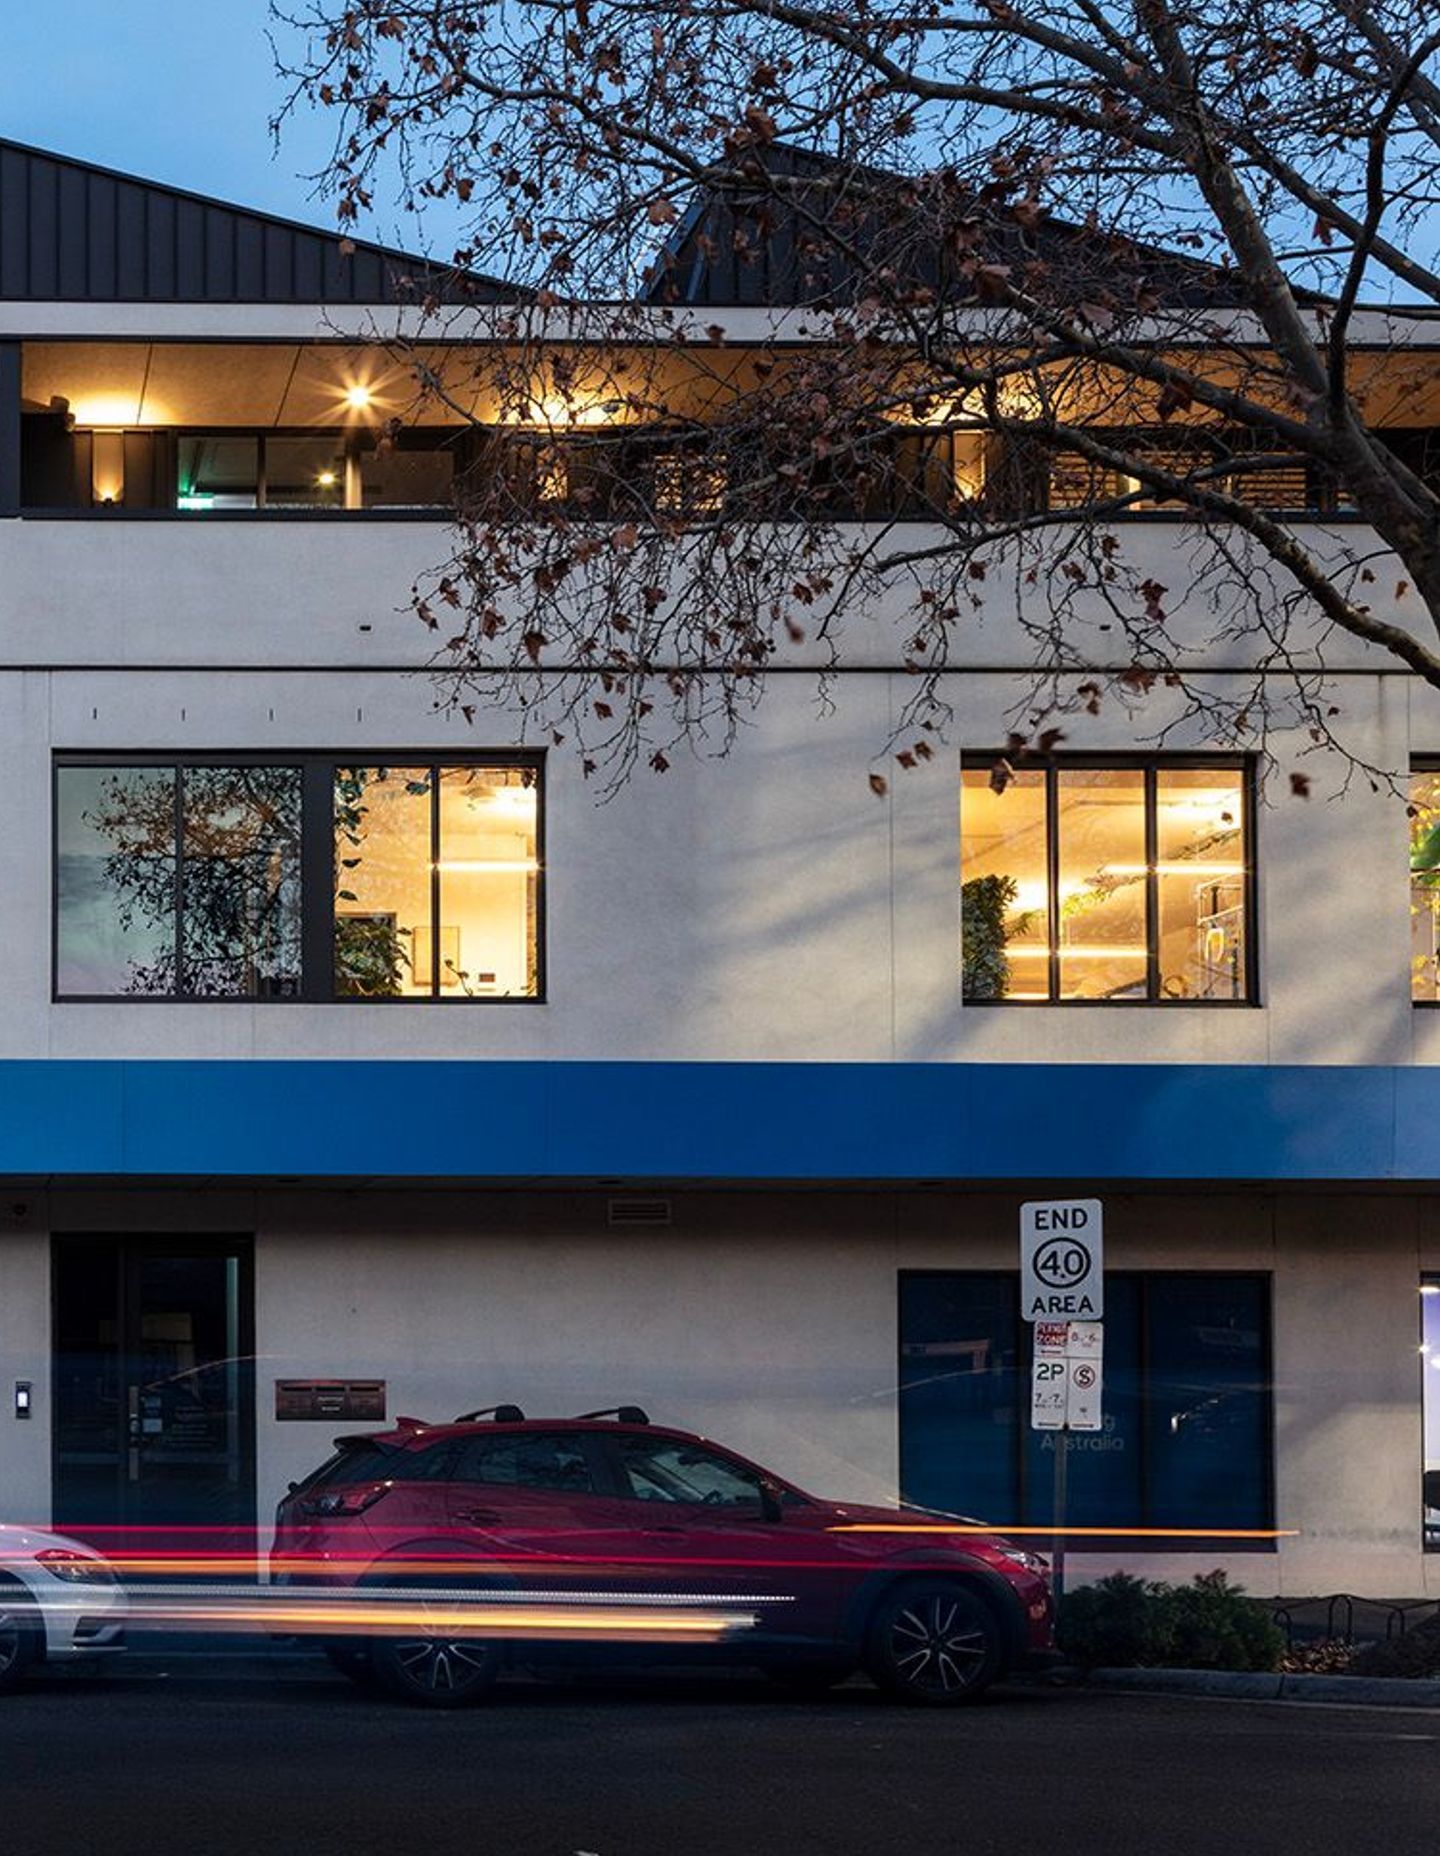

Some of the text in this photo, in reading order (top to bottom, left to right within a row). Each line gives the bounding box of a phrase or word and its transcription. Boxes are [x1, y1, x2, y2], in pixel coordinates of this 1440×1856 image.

[1034, 1208, 1088, 1230] END
[1040, 1250, 1084, 1276] 40
[1031, 1295, 1094, 1314] AREA
[1036, 1363, 1065, 1380] 2P
[1041, 1433, 1124, 1450] Astralia
